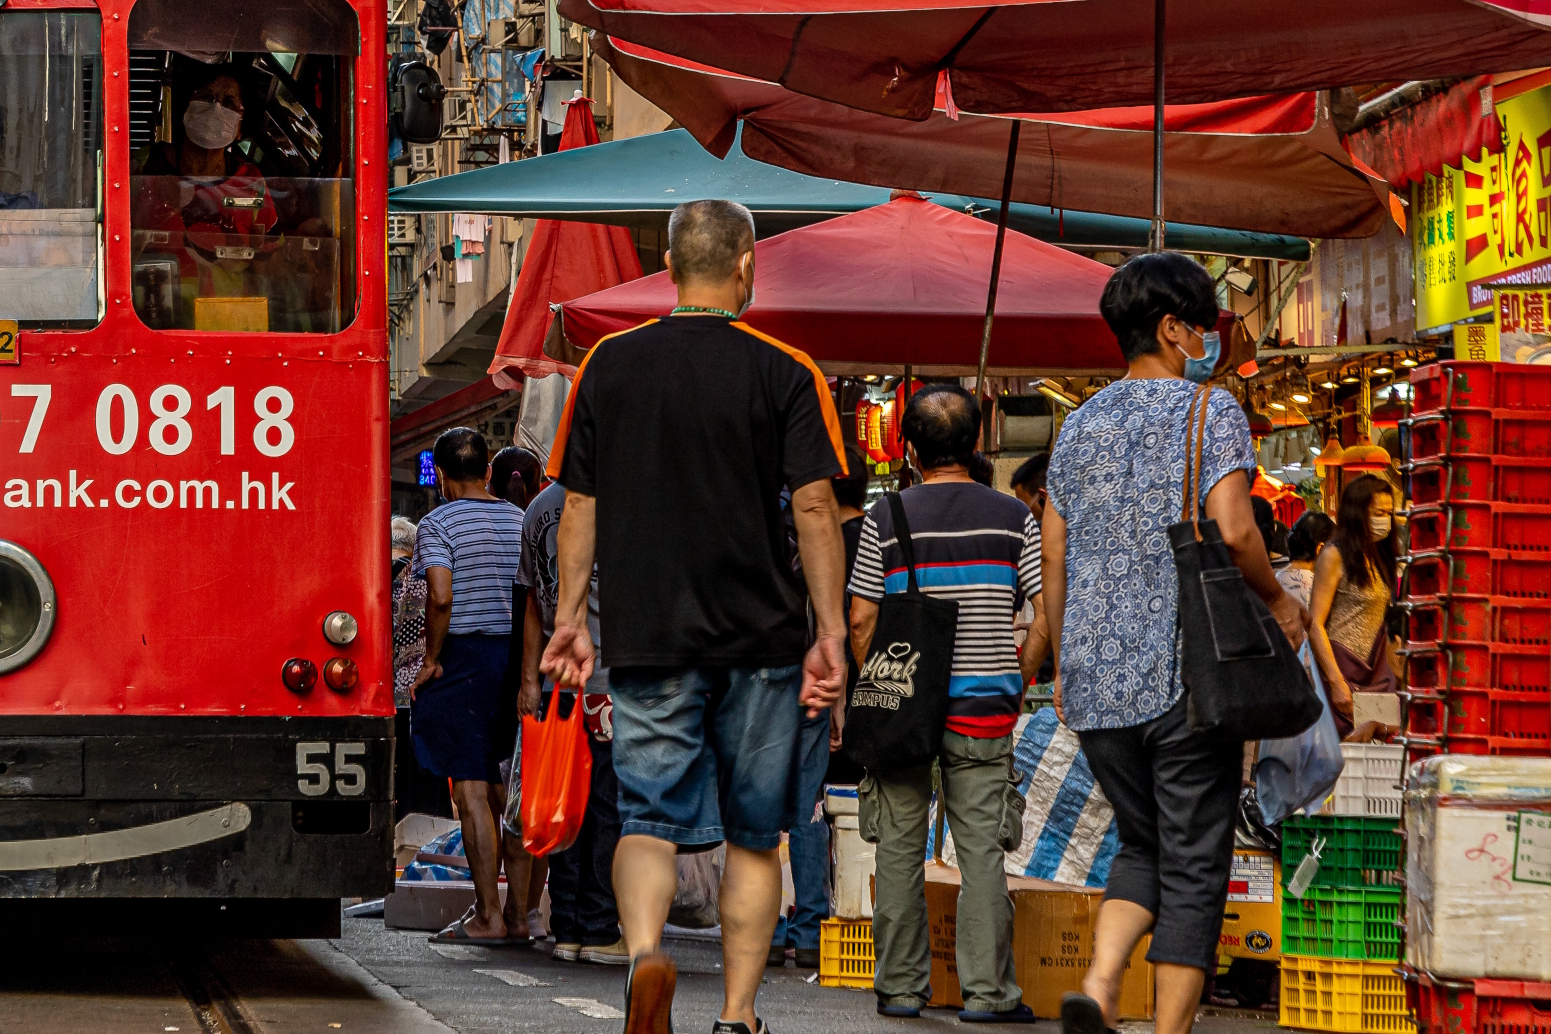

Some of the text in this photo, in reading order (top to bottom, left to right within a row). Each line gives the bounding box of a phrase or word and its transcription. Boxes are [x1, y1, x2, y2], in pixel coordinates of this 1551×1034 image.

[95, 383, 296, 458] 0818
[851, 691, 901, 711] CAMPUS
[296, 741, 367, 797] 55
[1061, 931, 1080, 942] KGS
[1061, 944, 1079, 955] KGS
